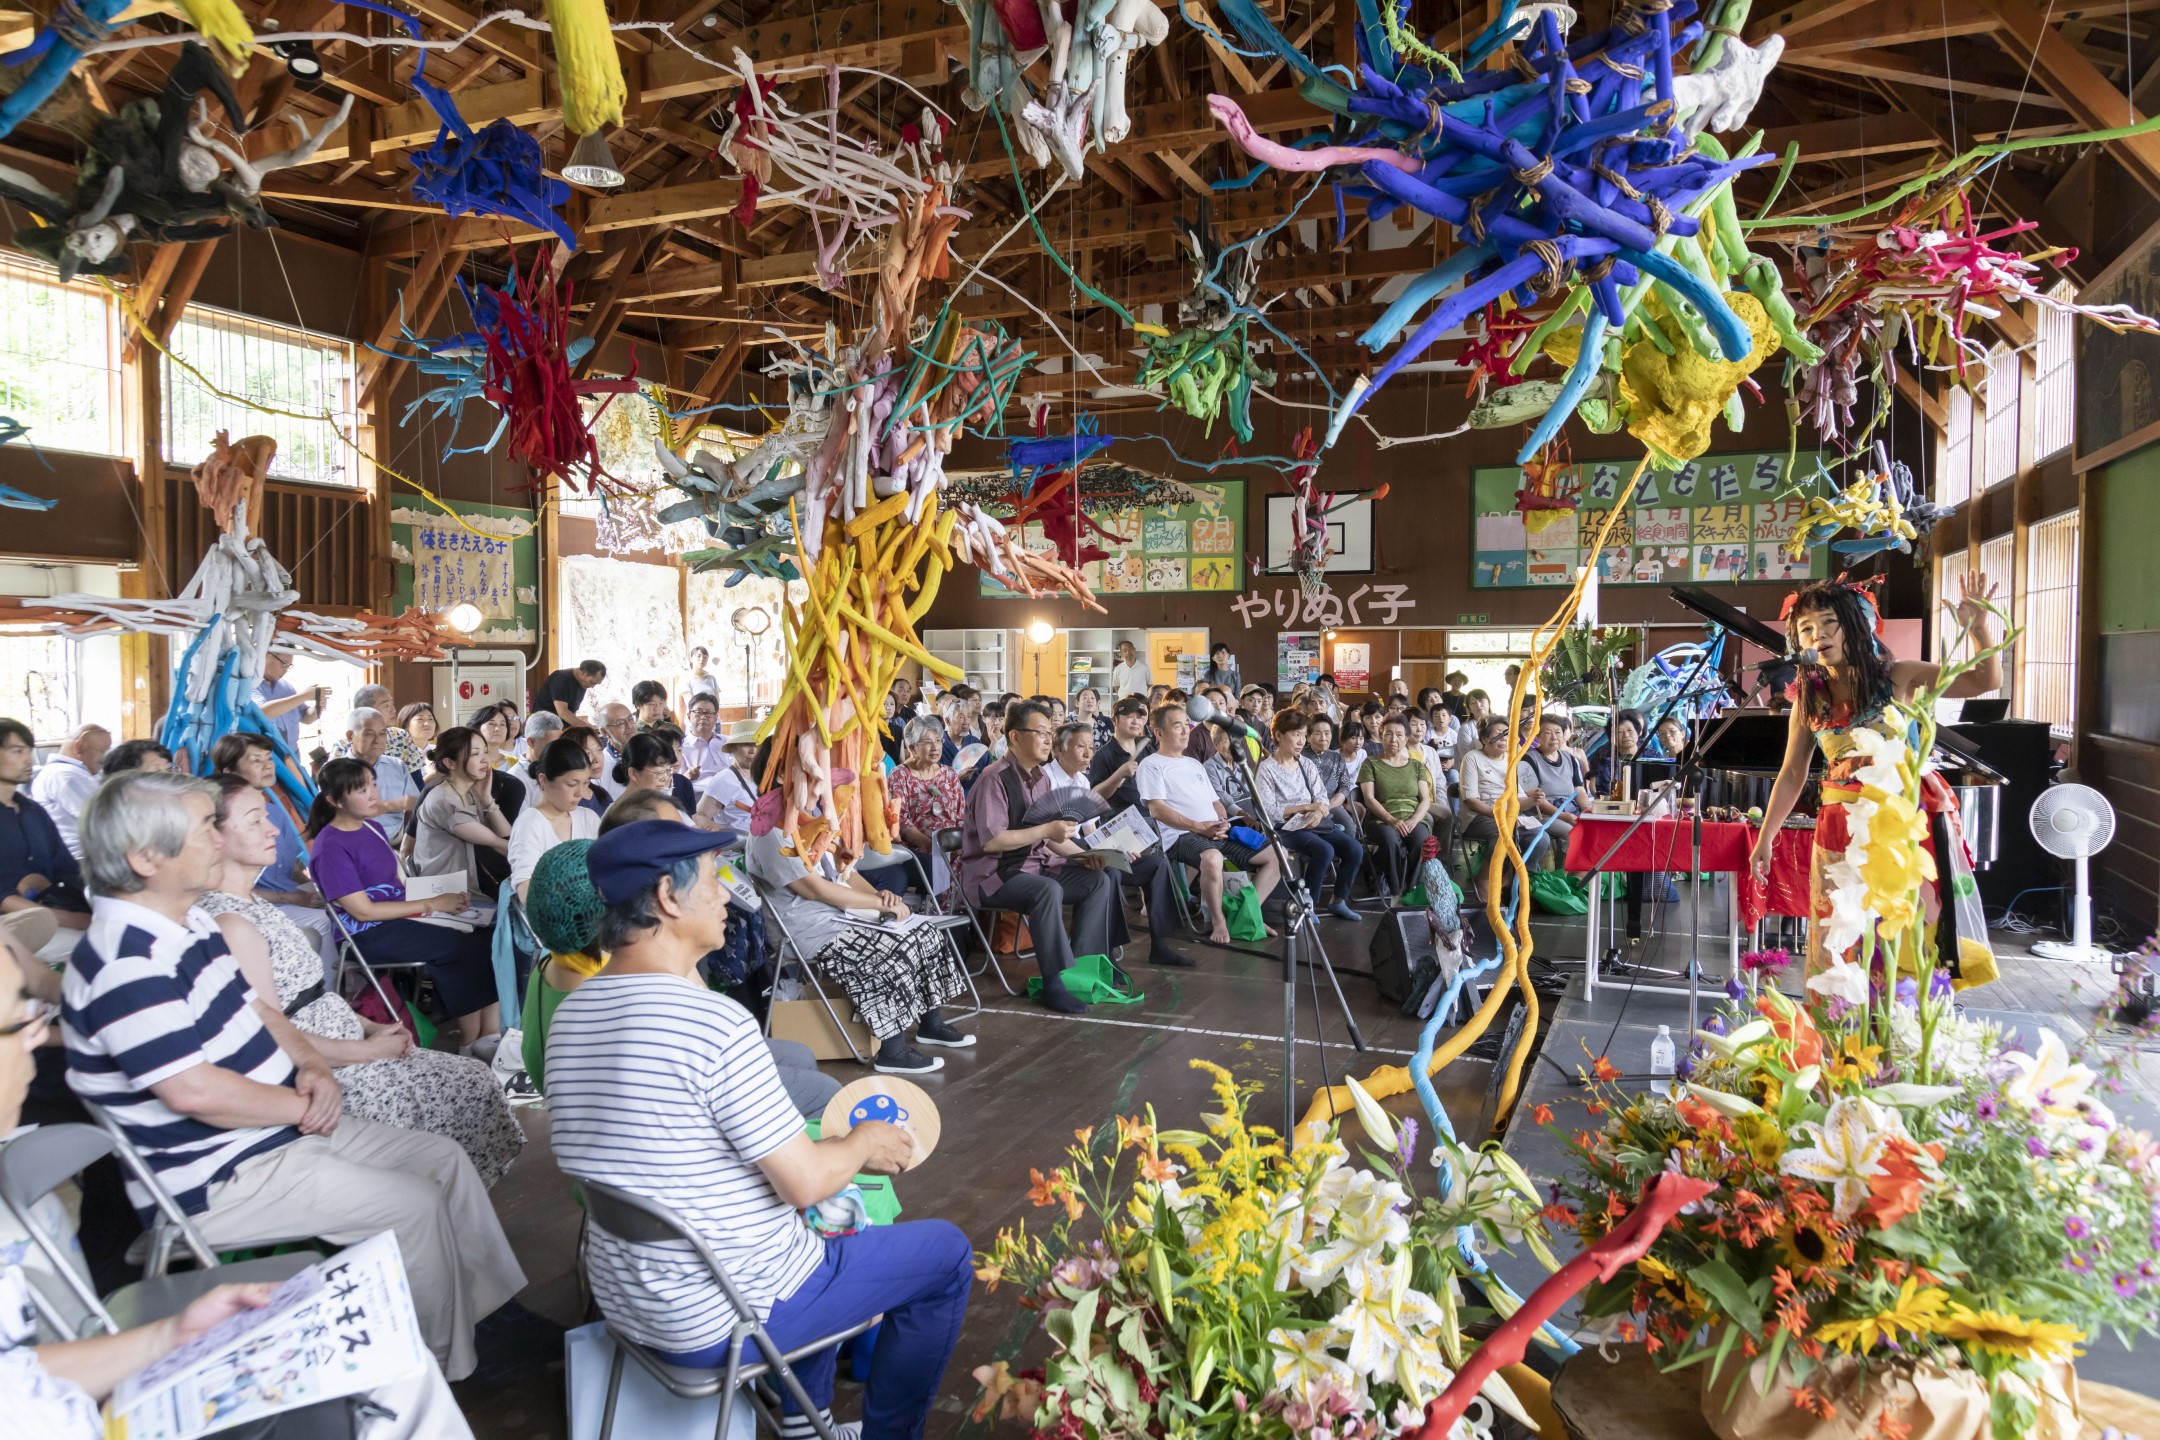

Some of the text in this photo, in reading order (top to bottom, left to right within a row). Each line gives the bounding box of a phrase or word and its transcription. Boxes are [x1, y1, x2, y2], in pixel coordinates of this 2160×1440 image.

[1647, 506, 1682, 521] 1月
[1700, 502, 1742, 522] 2月
[1760, 497, 1805, 523] 3月
[1195, 516, 1230, 539] 9月
[1636, 523, 1689, 543] 給食週間
[1694, 523, 1748, 541] スキー大会
[1230, 583, 1416, 629] やりぬく子
[325, 1261, 371, 1353] ヒネモス
